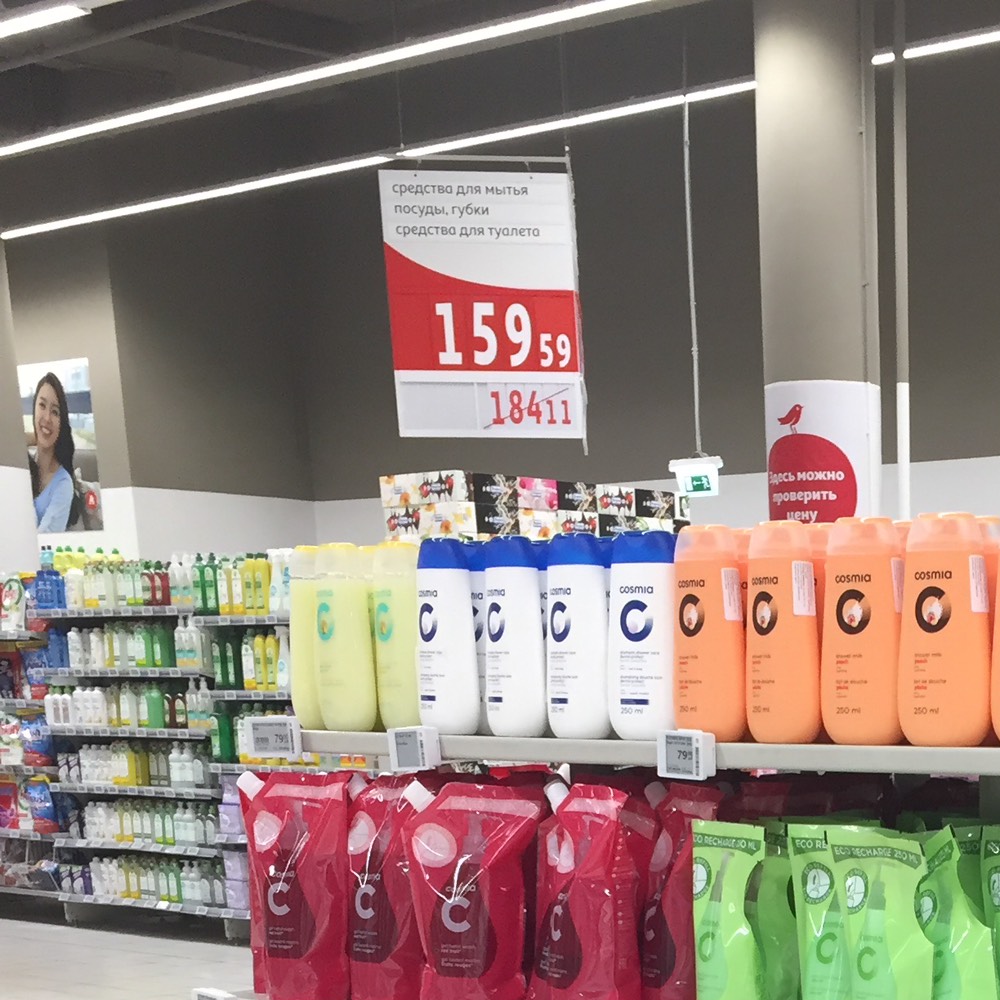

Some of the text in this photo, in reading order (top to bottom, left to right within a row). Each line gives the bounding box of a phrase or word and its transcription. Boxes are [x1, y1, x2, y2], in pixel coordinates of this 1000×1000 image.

[392, 183, 529, 197] средства для мытья
[394, 203, 490, 217] посуды, губки
[395, 225, 541, 240] средства для туалета
[435, 302, 572, 368] 159 59
[797, 470, 845, 482] можно
[773, 491, 837, 505] проверить
[786, 510, 818, 524] цену
[835, 573, 872, 584] cosmia
[914, 570, 952, 580] cosmia
[678, 579, 705, 588] cosmia
[751, 576, 779, 586] cosmia
[619, 585, 654, 594] cosmia
[795, 839, 814, 849] ECO
[834, 846, 851, 856] ECO
